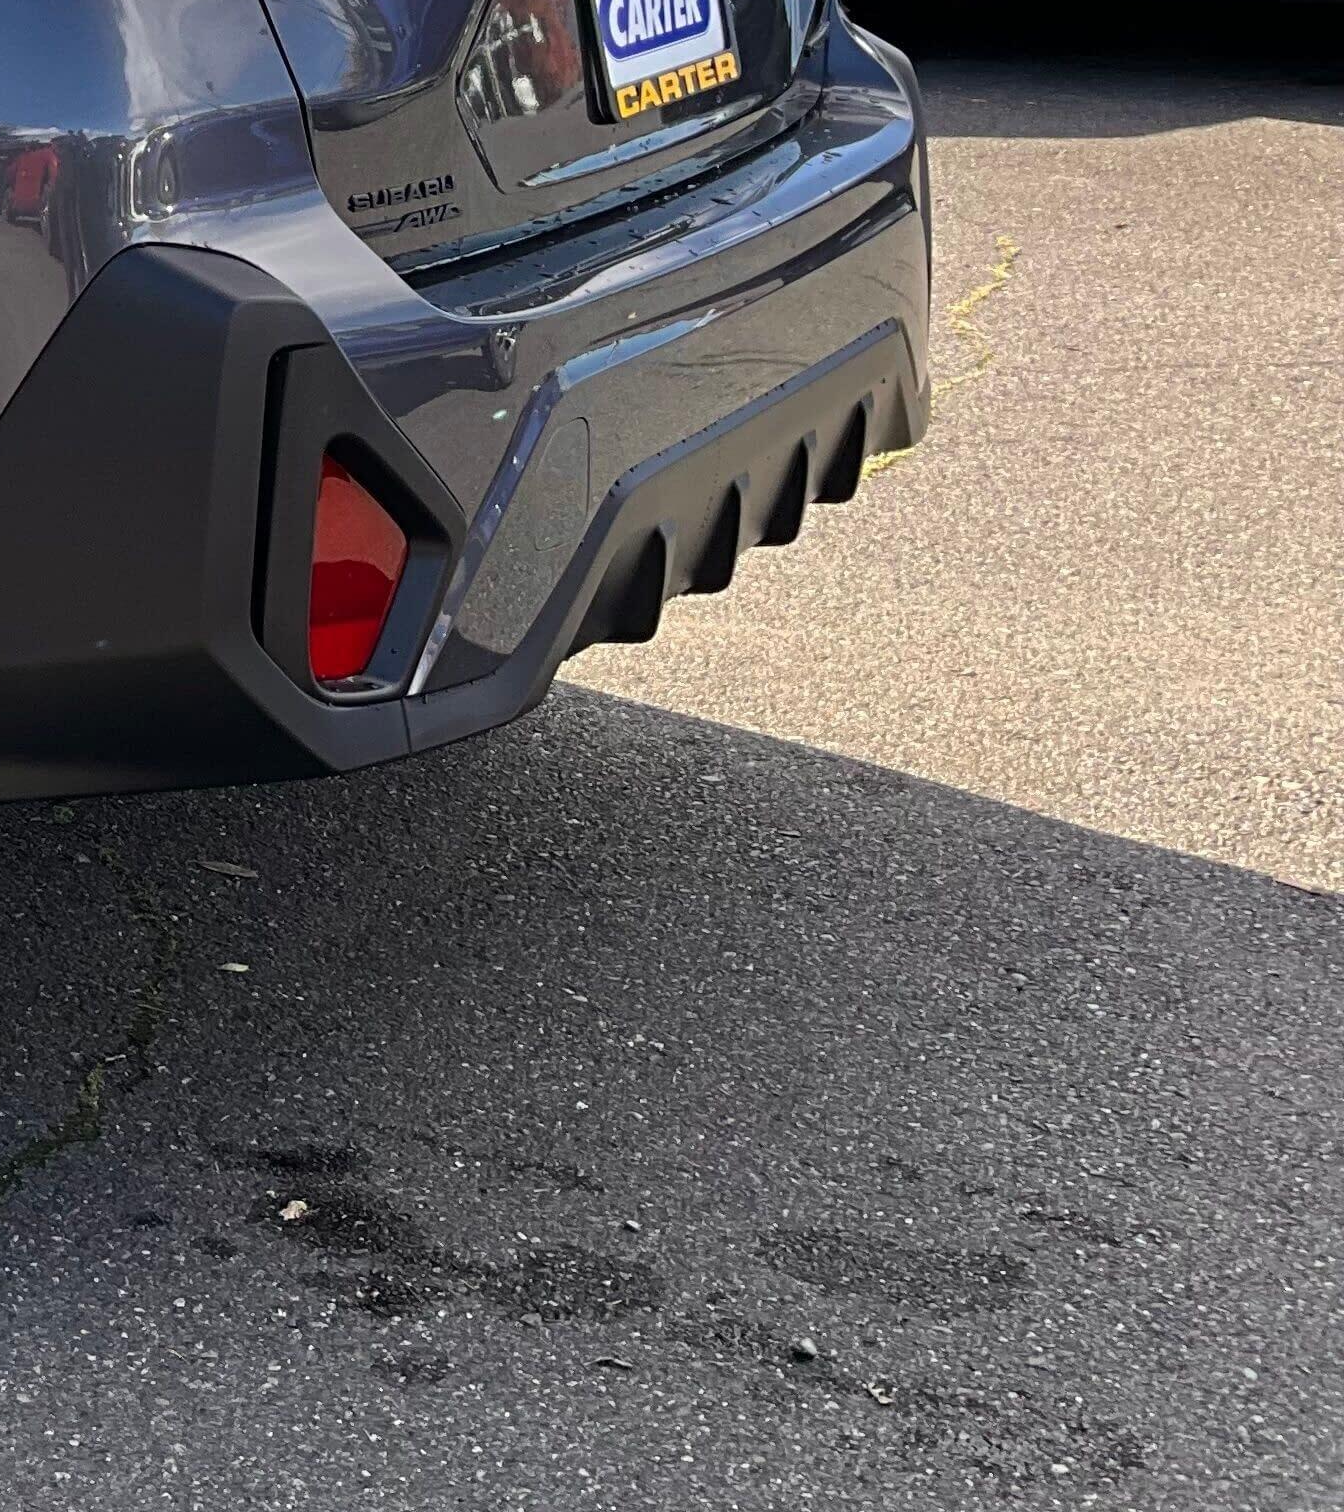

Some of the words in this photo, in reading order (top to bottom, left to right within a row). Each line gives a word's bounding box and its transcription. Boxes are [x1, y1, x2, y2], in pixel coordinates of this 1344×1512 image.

[615, 51, 739, 120] CARTER
[347, 174, 454, 213] SUBARU
[393, 202, 461, 233] AWD
